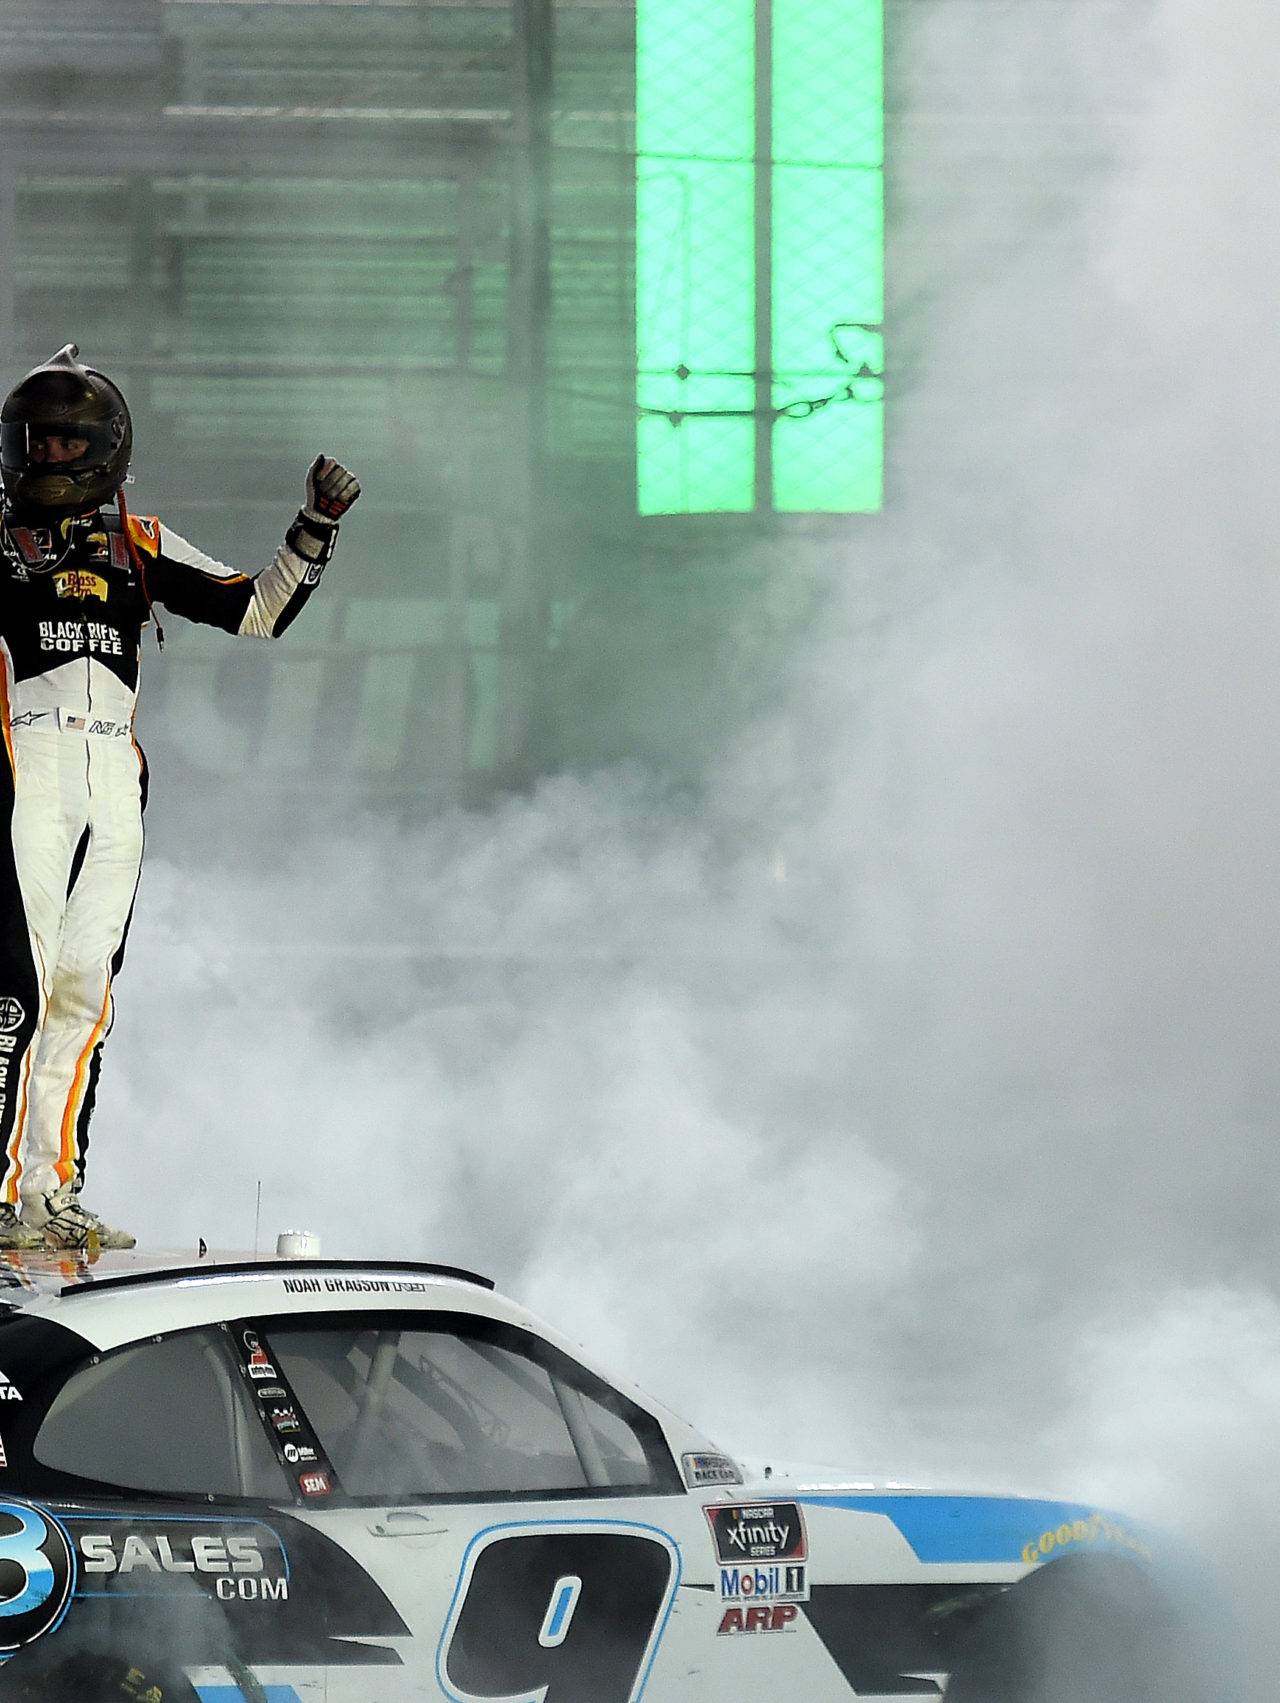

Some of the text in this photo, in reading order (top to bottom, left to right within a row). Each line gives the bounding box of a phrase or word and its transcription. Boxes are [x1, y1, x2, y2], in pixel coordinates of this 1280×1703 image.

[39, 621, 84, 640] BLACK
[40, 638, 123, 655] COFFEE
[282, 1279, 321, 1293] NOAH
[324, 1279, 390, 1292] GRAGSON
[303, 1477, 327, 1493] SEM
[741, 1508, 775, 1519] NASCAR
[726, 1521, 790, 1552] xfinity
[83, 1535, 263, 1576] SALES
[750, 1546, 777, 1557] SERIES
[721, 1567, 780, 1597] Mobil
[440, 1526, 677, 1703] 9
[717, 1605, 799, 1633] ARP
